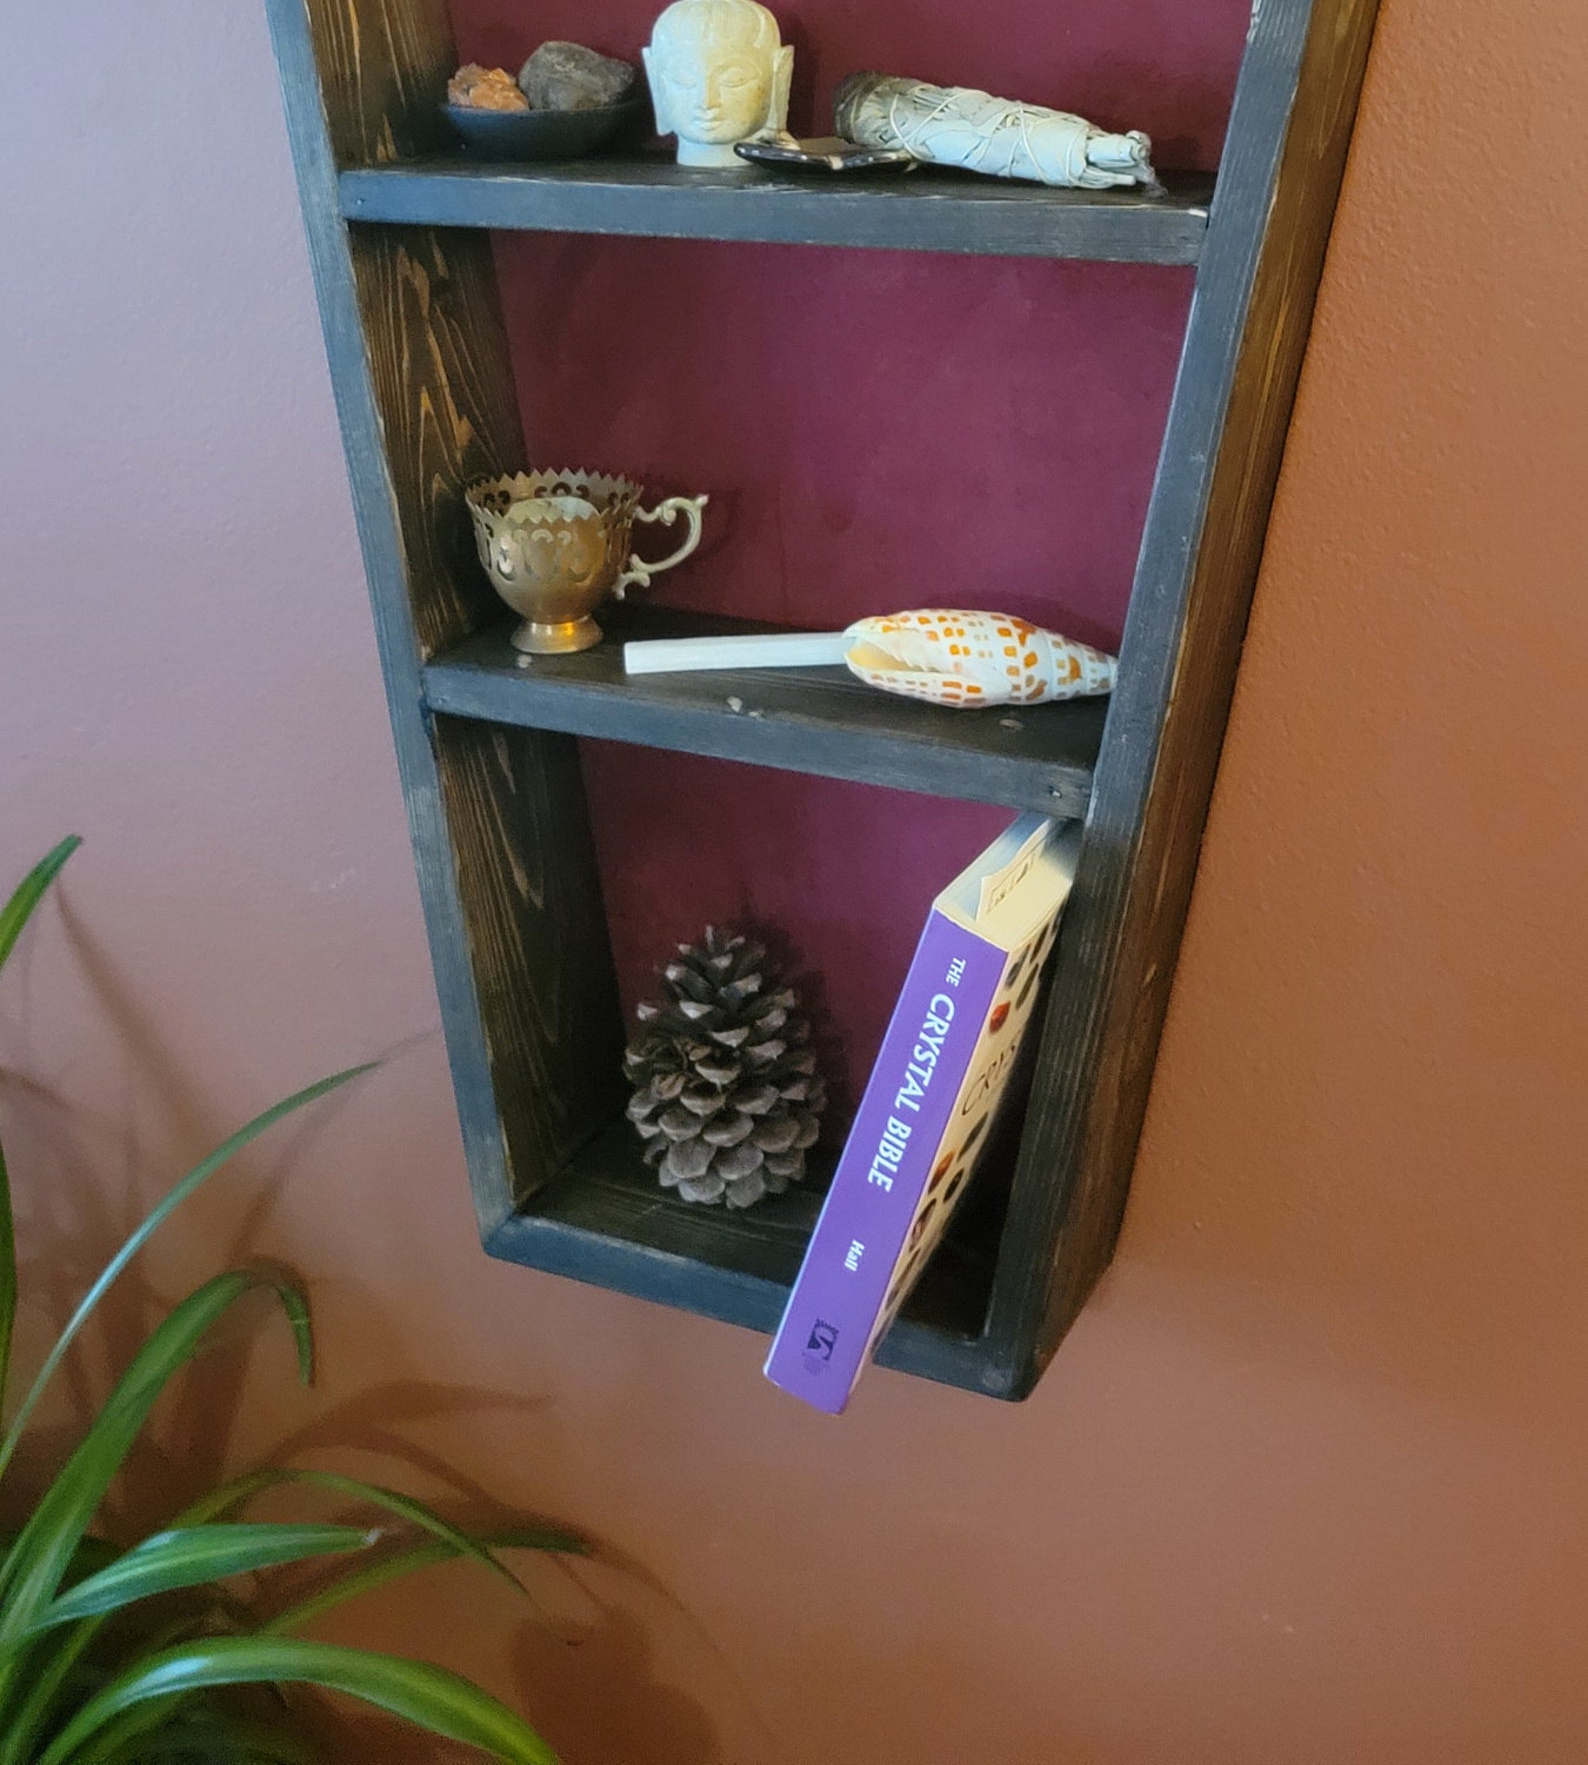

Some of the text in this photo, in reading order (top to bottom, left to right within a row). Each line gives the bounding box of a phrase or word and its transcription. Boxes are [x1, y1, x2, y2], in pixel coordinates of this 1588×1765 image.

[867, 957, 967, 1193] THE CRYSTAL BIBLE
[844, 1239, 865, 1272] Hall
